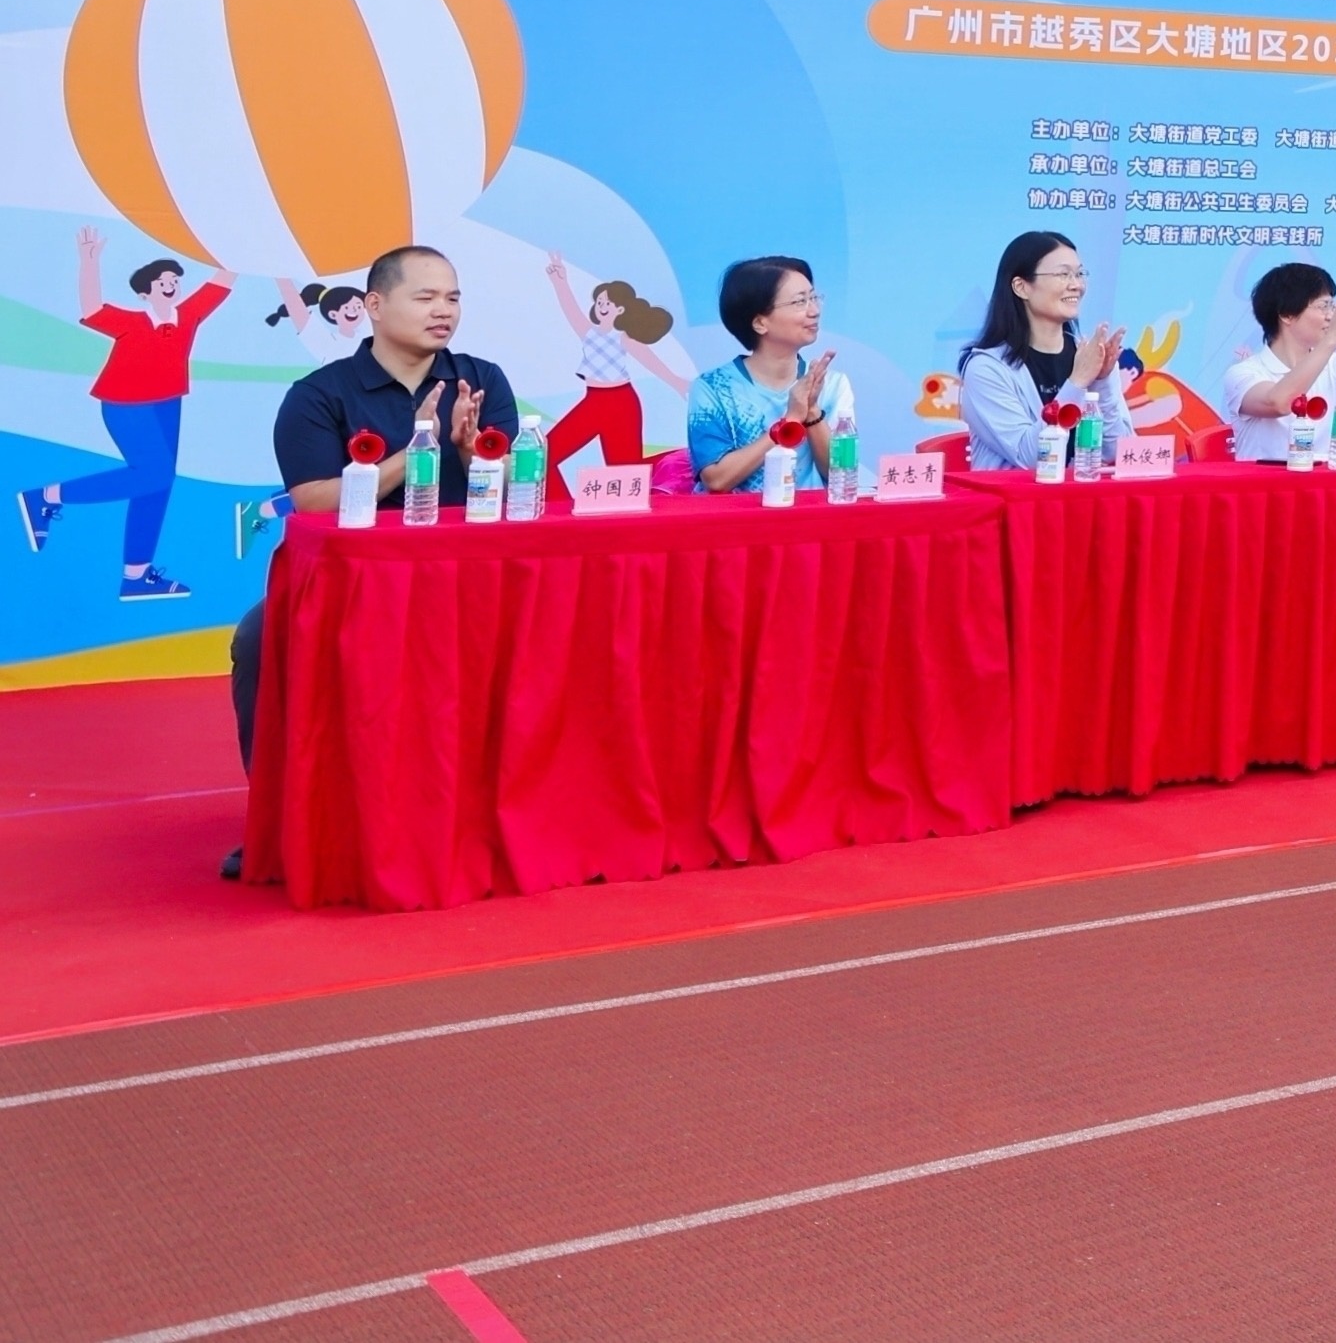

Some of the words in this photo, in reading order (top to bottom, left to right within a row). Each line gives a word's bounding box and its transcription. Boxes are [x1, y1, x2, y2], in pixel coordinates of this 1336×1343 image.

[1123, 224, 1323, 246] 大塘街新时代文明实践所
[1121, 446, 1172, 467] 林俊娜
[882, 462, 938, 486] 黄志青
[582, 477, 642, 500] 钟国勇
